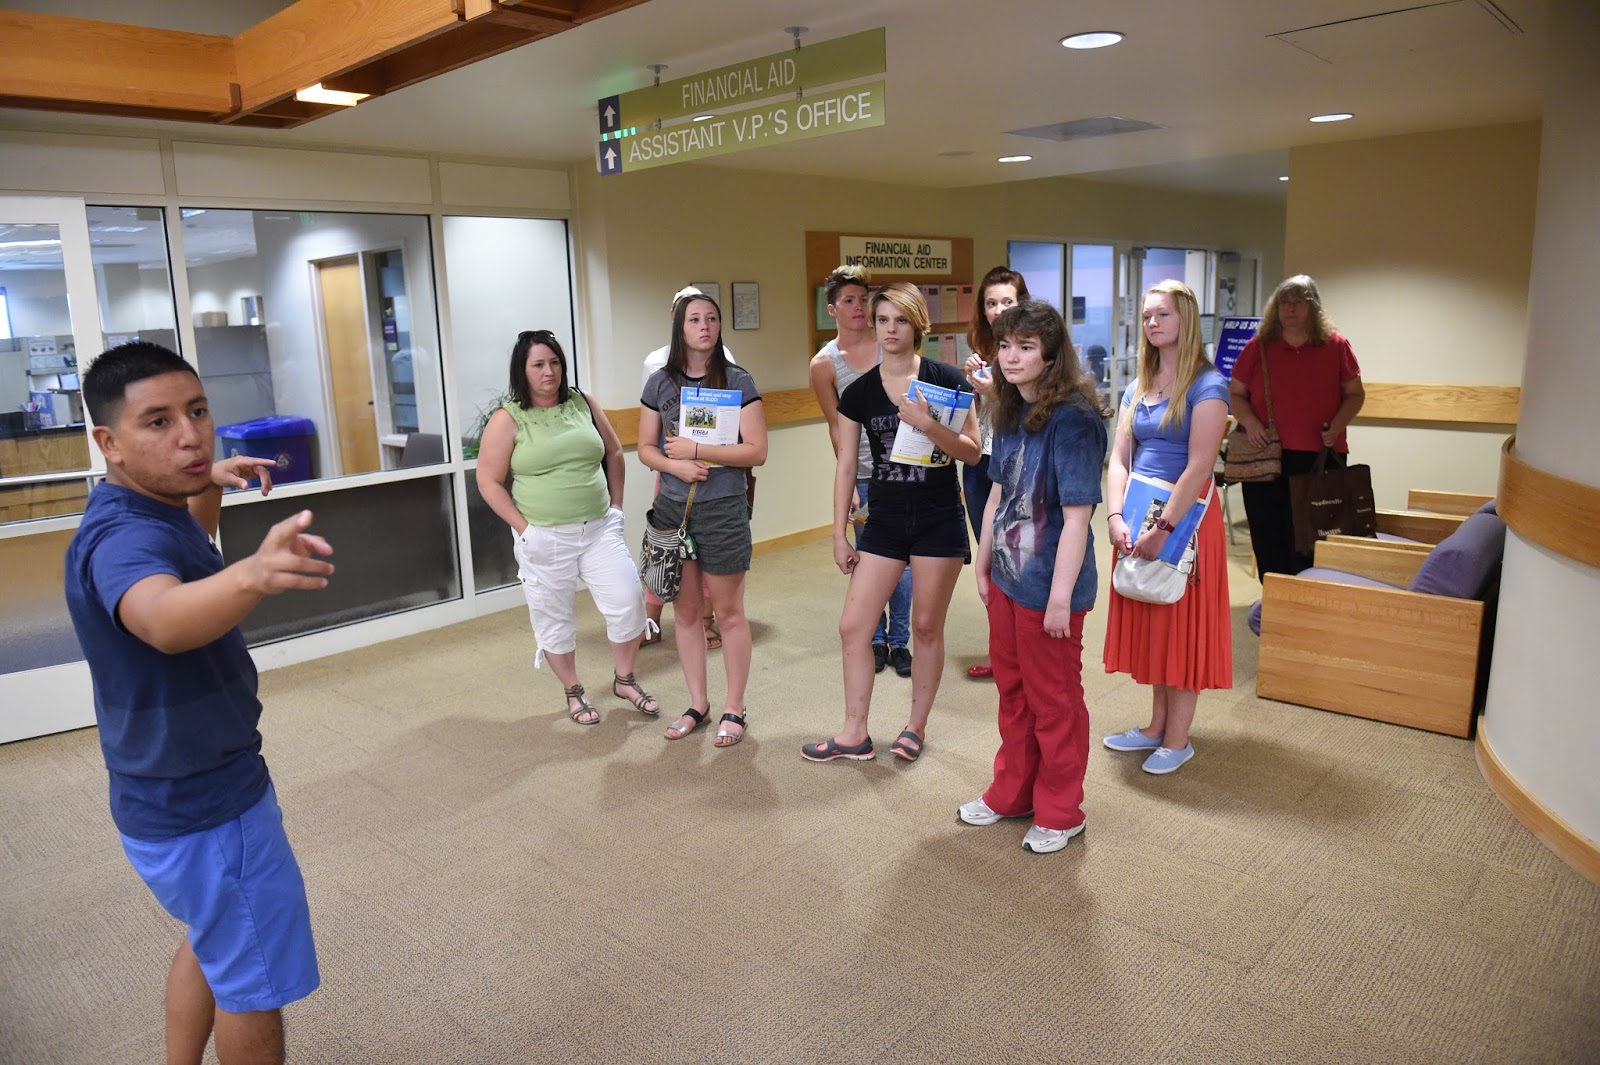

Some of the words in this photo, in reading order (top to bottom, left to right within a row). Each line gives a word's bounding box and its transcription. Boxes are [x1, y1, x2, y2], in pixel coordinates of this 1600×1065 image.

[682, 66, 763, 109] FINANCIAL
[767, 58, 796, 89] AID
[629, 121, 726, 163] ASSISTANT
[732, 108, 789, 142] V.P.'S
[796, 91, 872, 131] OFFICE
[846, 255, 910, 269] INFORMATION
[913, 257, 948, 269] CENTER
[865, 241, 913, 255] FINANCIAL
[917, 244, 931, 256] AID
